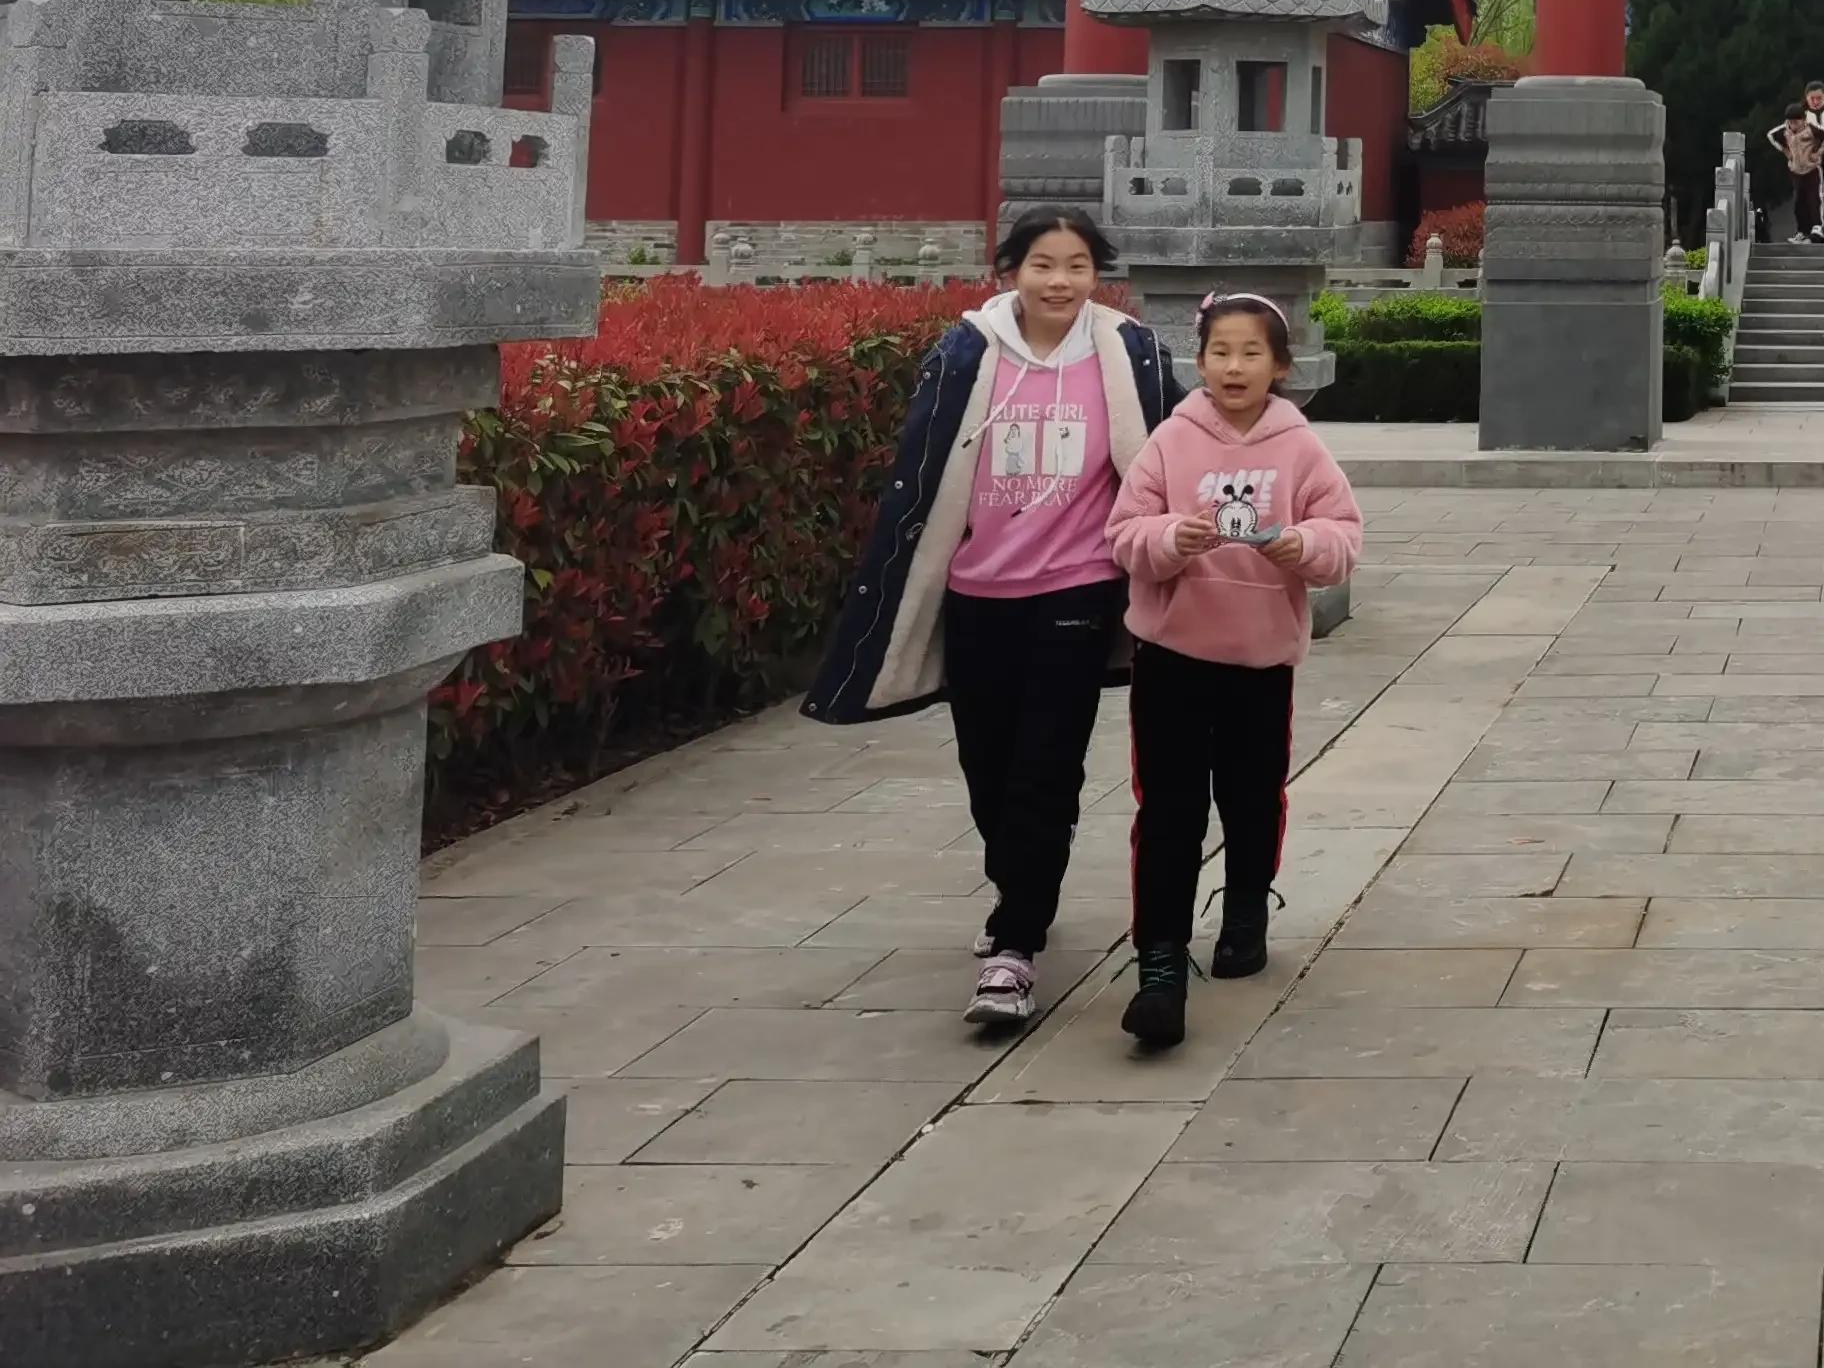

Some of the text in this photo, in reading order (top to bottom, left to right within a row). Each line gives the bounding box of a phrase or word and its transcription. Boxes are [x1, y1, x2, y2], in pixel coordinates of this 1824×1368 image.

[1045, 403, 1088, 421] GIRL
[992, 476, 1078, 492] NO MORE
[978, 491, 1026, 507] FEAR
